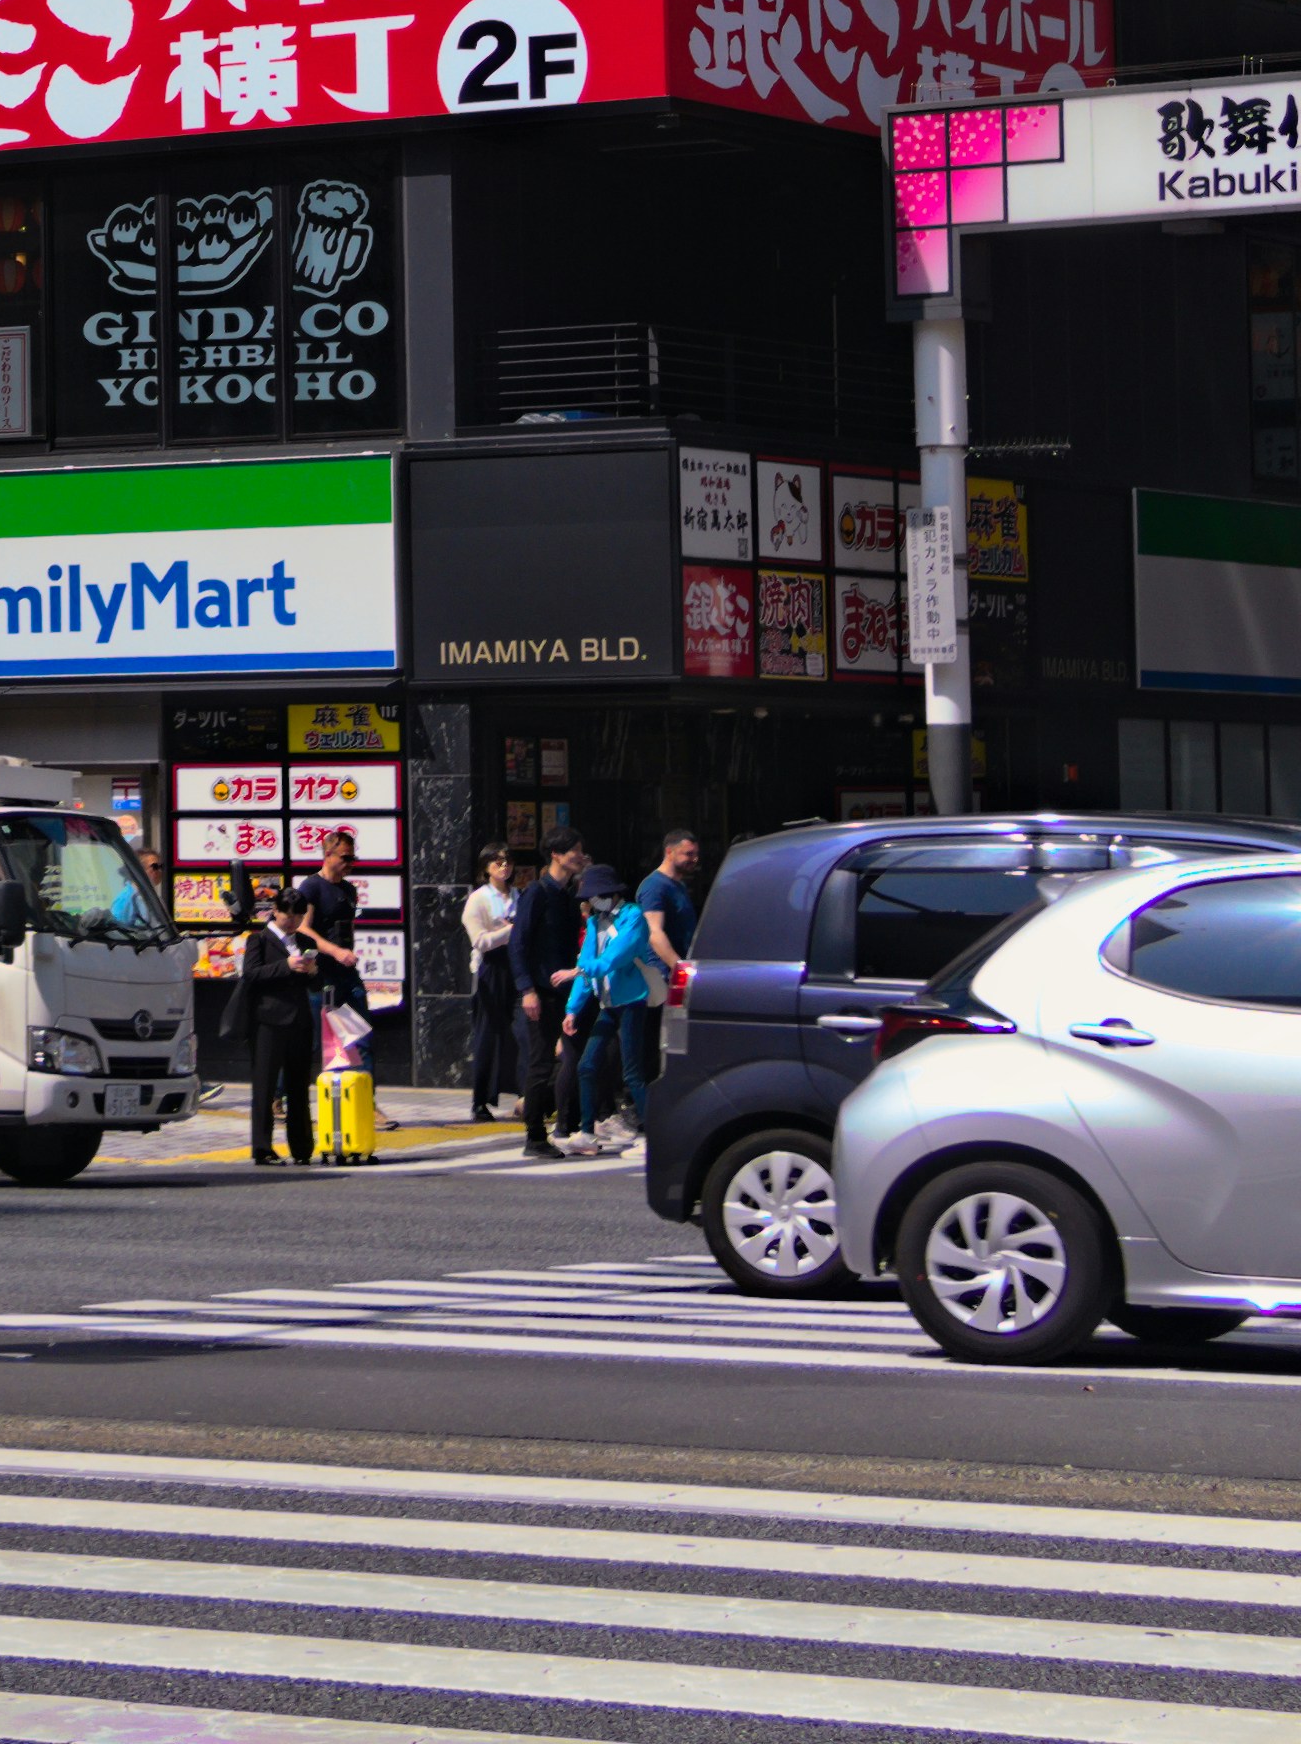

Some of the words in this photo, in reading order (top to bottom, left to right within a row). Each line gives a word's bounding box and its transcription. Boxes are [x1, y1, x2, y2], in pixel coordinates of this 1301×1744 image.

[167, 13, 415, 130] 横丁
[457, 18, 579, 106] 2F
[117, 341, 354, 370] HIGHBALL
[0, 338, 12, 430] こだわりのソース
[103, 368, 377, 407] YOKOCHO
[854, 504, 908, 552] カラ
[684, 574, 750, 638] 銀だこ
[758, 574, 814, 631] 焼肉
[438, 635, 571, 666] IMAMIYA
[578, 635, 649, 664] BLD.
[303, 729, 384, 750] ウェルカム
